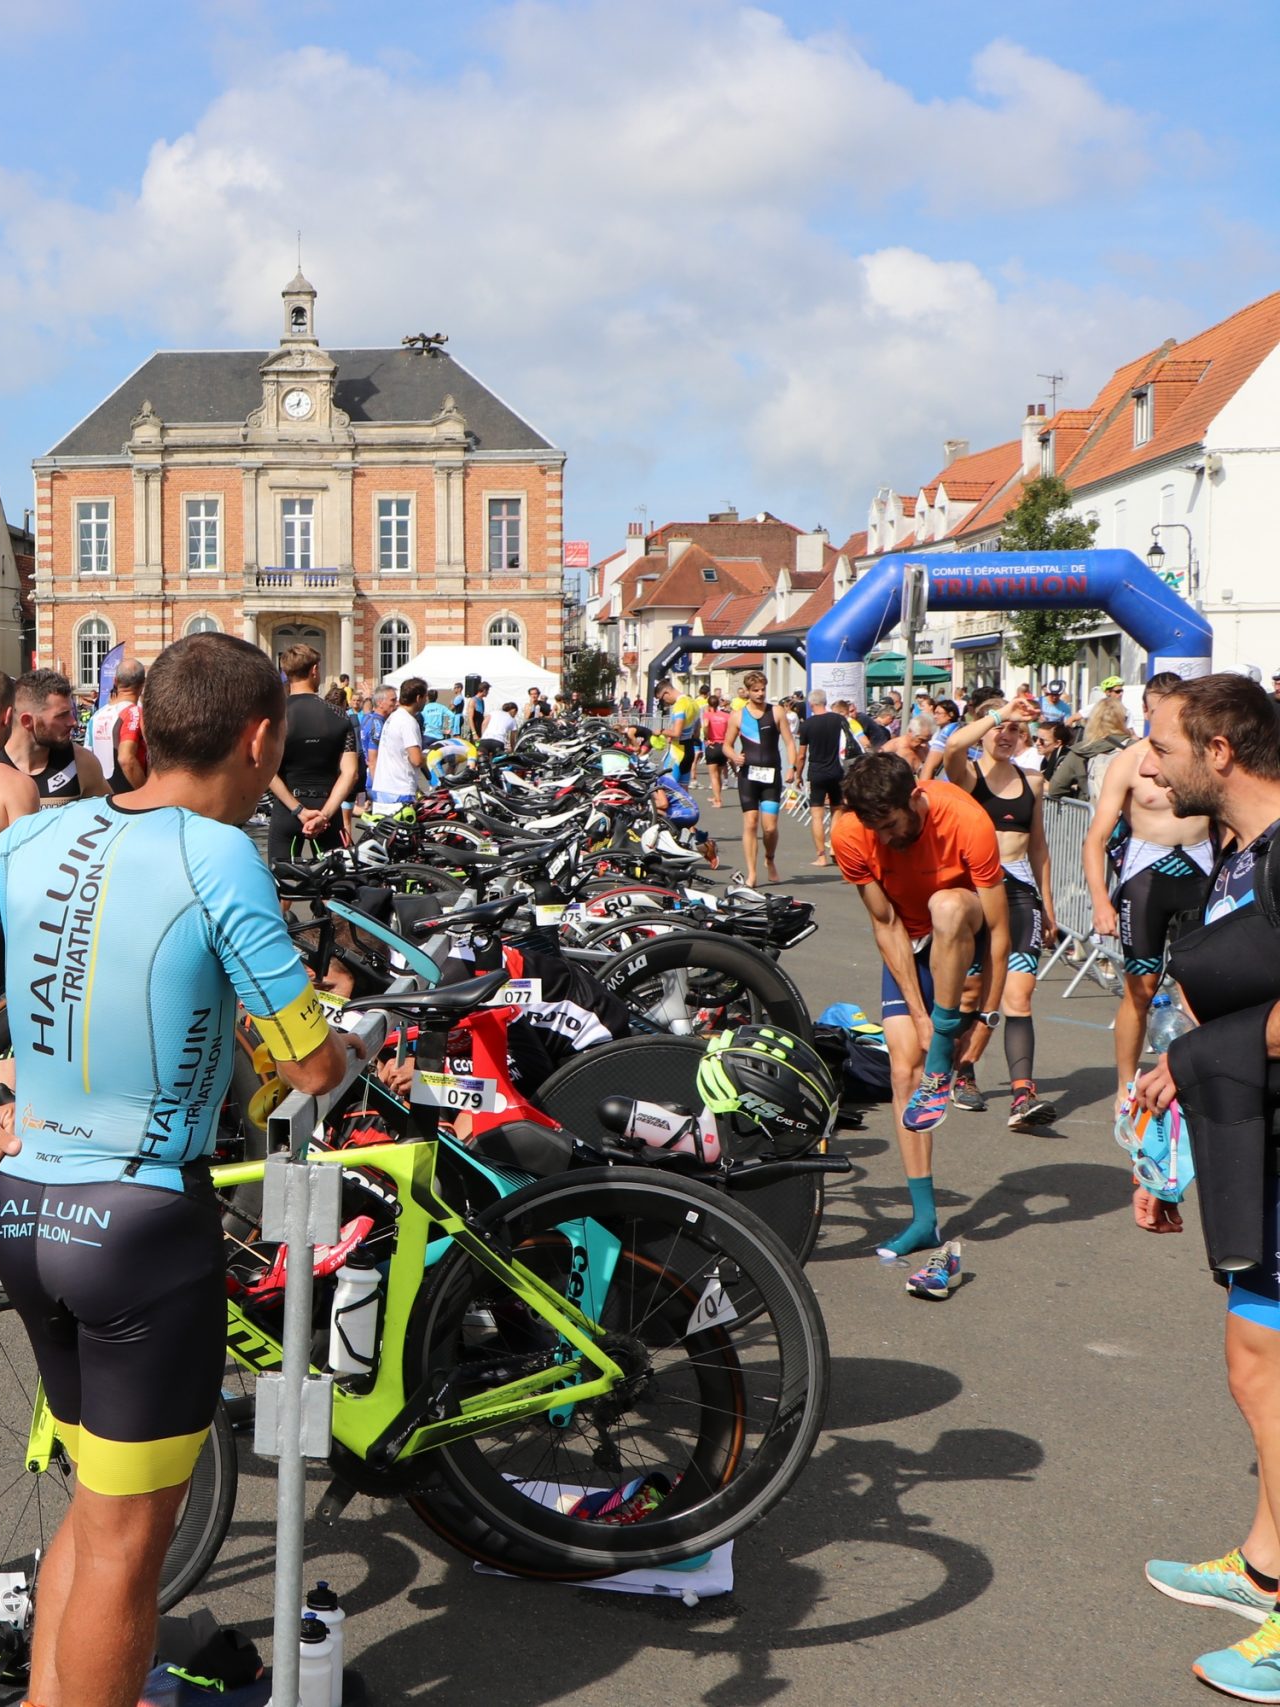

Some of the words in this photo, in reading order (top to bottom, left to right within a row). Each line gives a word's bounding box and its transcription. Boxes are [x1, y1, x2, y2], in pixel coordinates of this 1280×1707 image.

[932, 566, 972, 577] COMITÉ
[1071, 564, 1086, 573] DE
[933, 575, 1088, 597] TRIATHLON
[560, 911, 582, 923] 075
[31, 814, 113, 1056] HALLUIN
[61, 863, 105, 1003] TRIATHLON
[504, 991, 532, 1003] 077
[140, 1007, 212, 1159] HALLUIN
[184, 1035, 223, 1128] TRIATHLON
[447, 1089, 483, 1109] 079
[738, 1091, 785, 1119] RS
[35, 1151, 64, 1164] TACTIC
[2, 1222, 71, 1245] TRIATHLON
